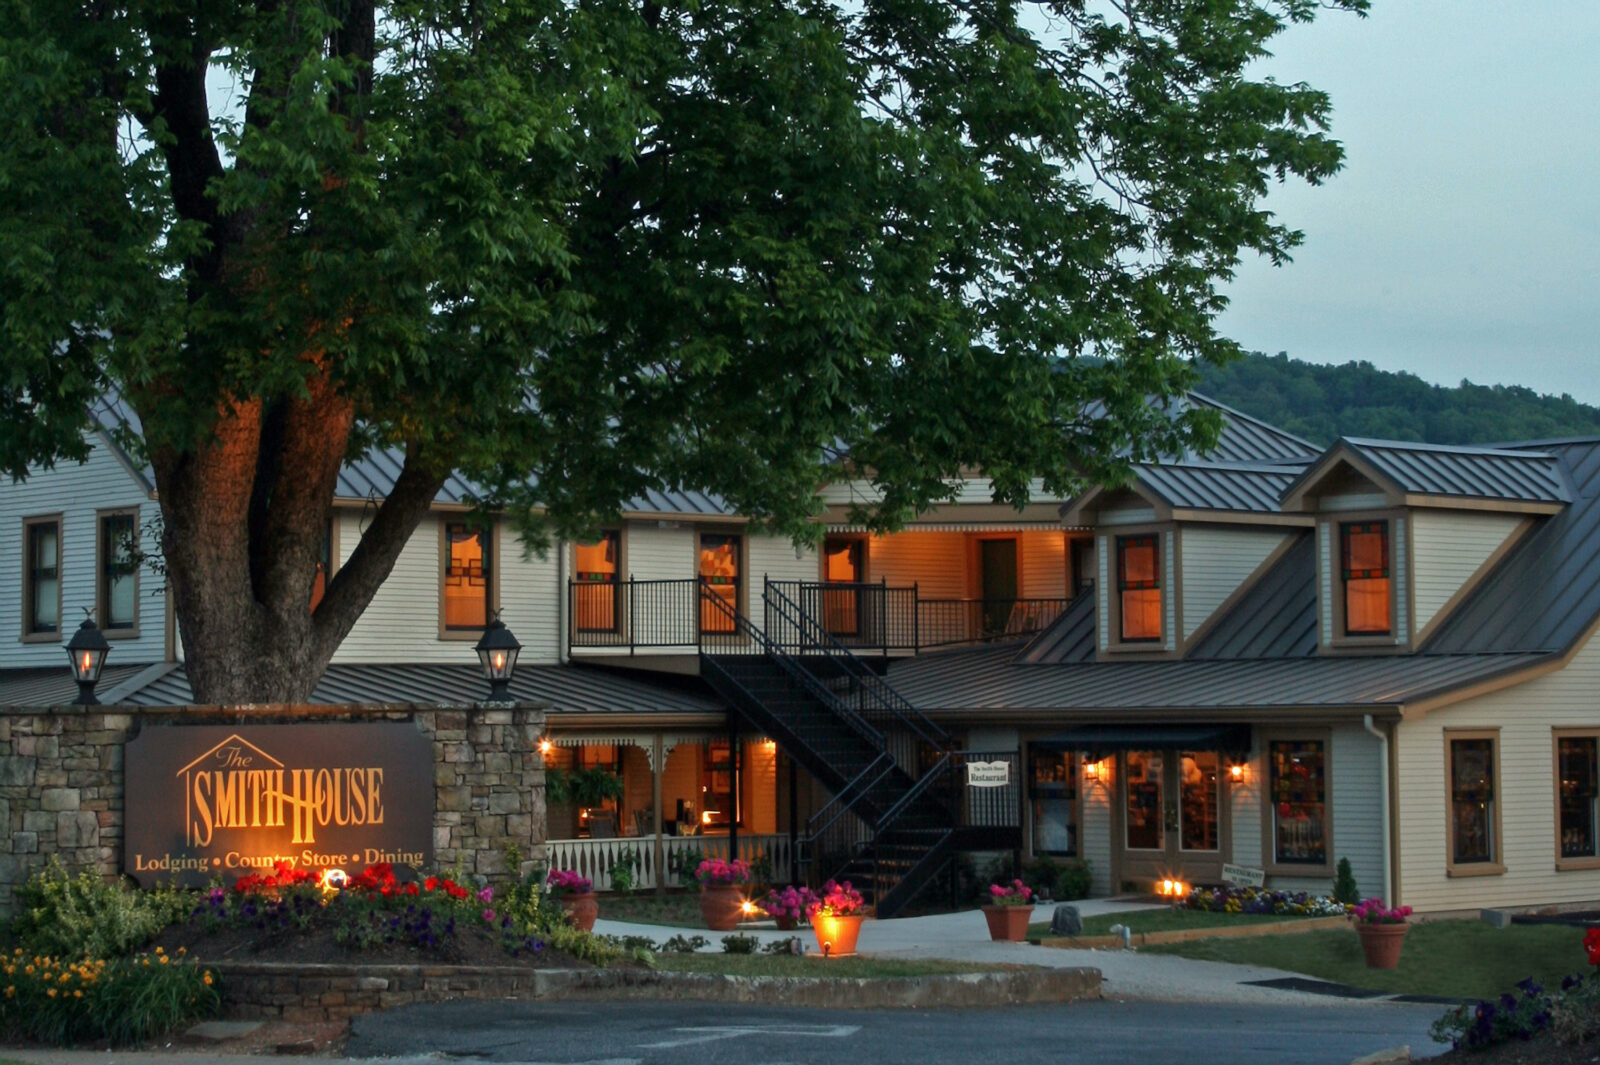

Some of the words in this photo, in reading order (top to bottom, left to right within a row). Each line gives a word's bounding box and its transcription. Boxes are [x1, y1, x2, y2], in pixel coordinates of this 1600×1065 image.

[215, 746, 253, 768] The
[971, 773, 1007, 781] Restaurant
[194, 769, 286, 848] SMITH
[291, 767, 385, 844] HOUSE
[136, 853, 209, 873] Lodging
[225, 851, 299, 870] Country
[301, 849, 348, 867] Store
[363, 847, 424, 866] Dining
